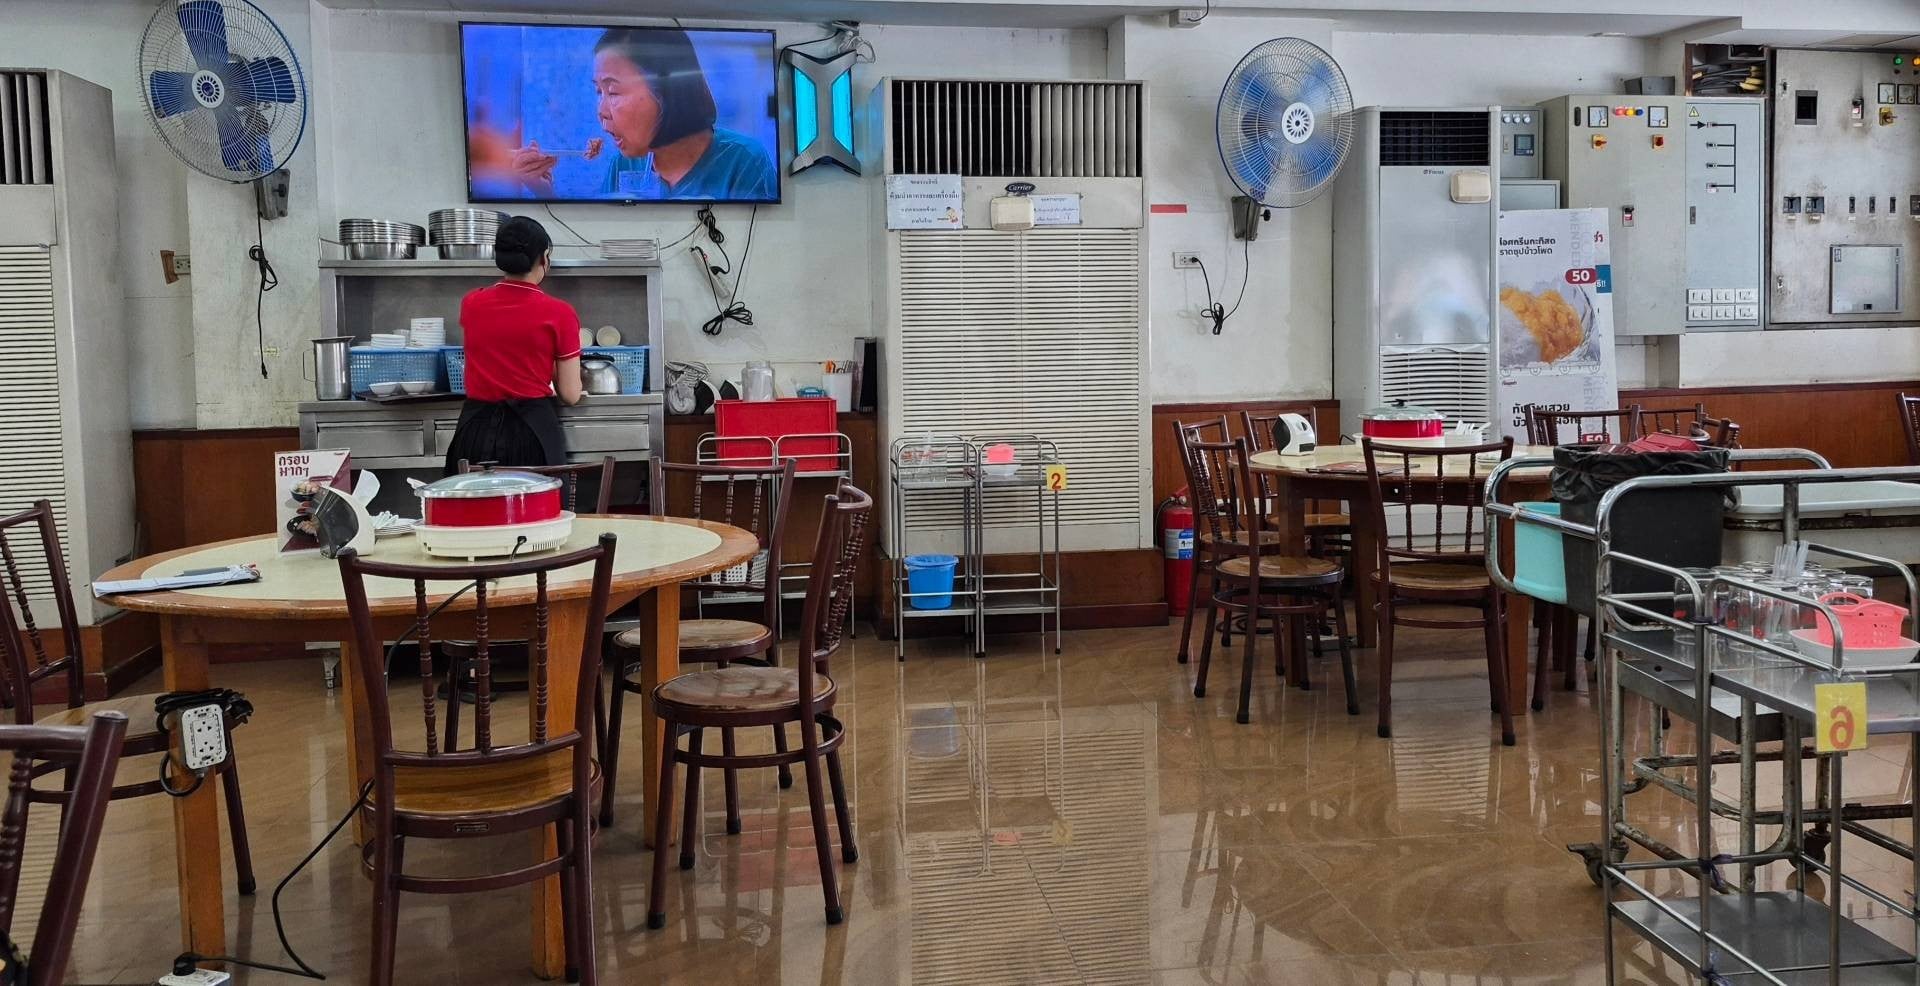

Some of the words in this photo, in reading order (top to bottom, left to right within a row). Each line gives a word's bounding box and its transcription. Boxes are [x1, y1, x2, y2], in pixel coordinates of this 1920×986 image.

[1571, 270, 1590, 282] 50
[278, 455, 310, 466] กรอบ
[279, 466, 310, 477] มากๆ
[1051, 472, 1062, 490] 2
